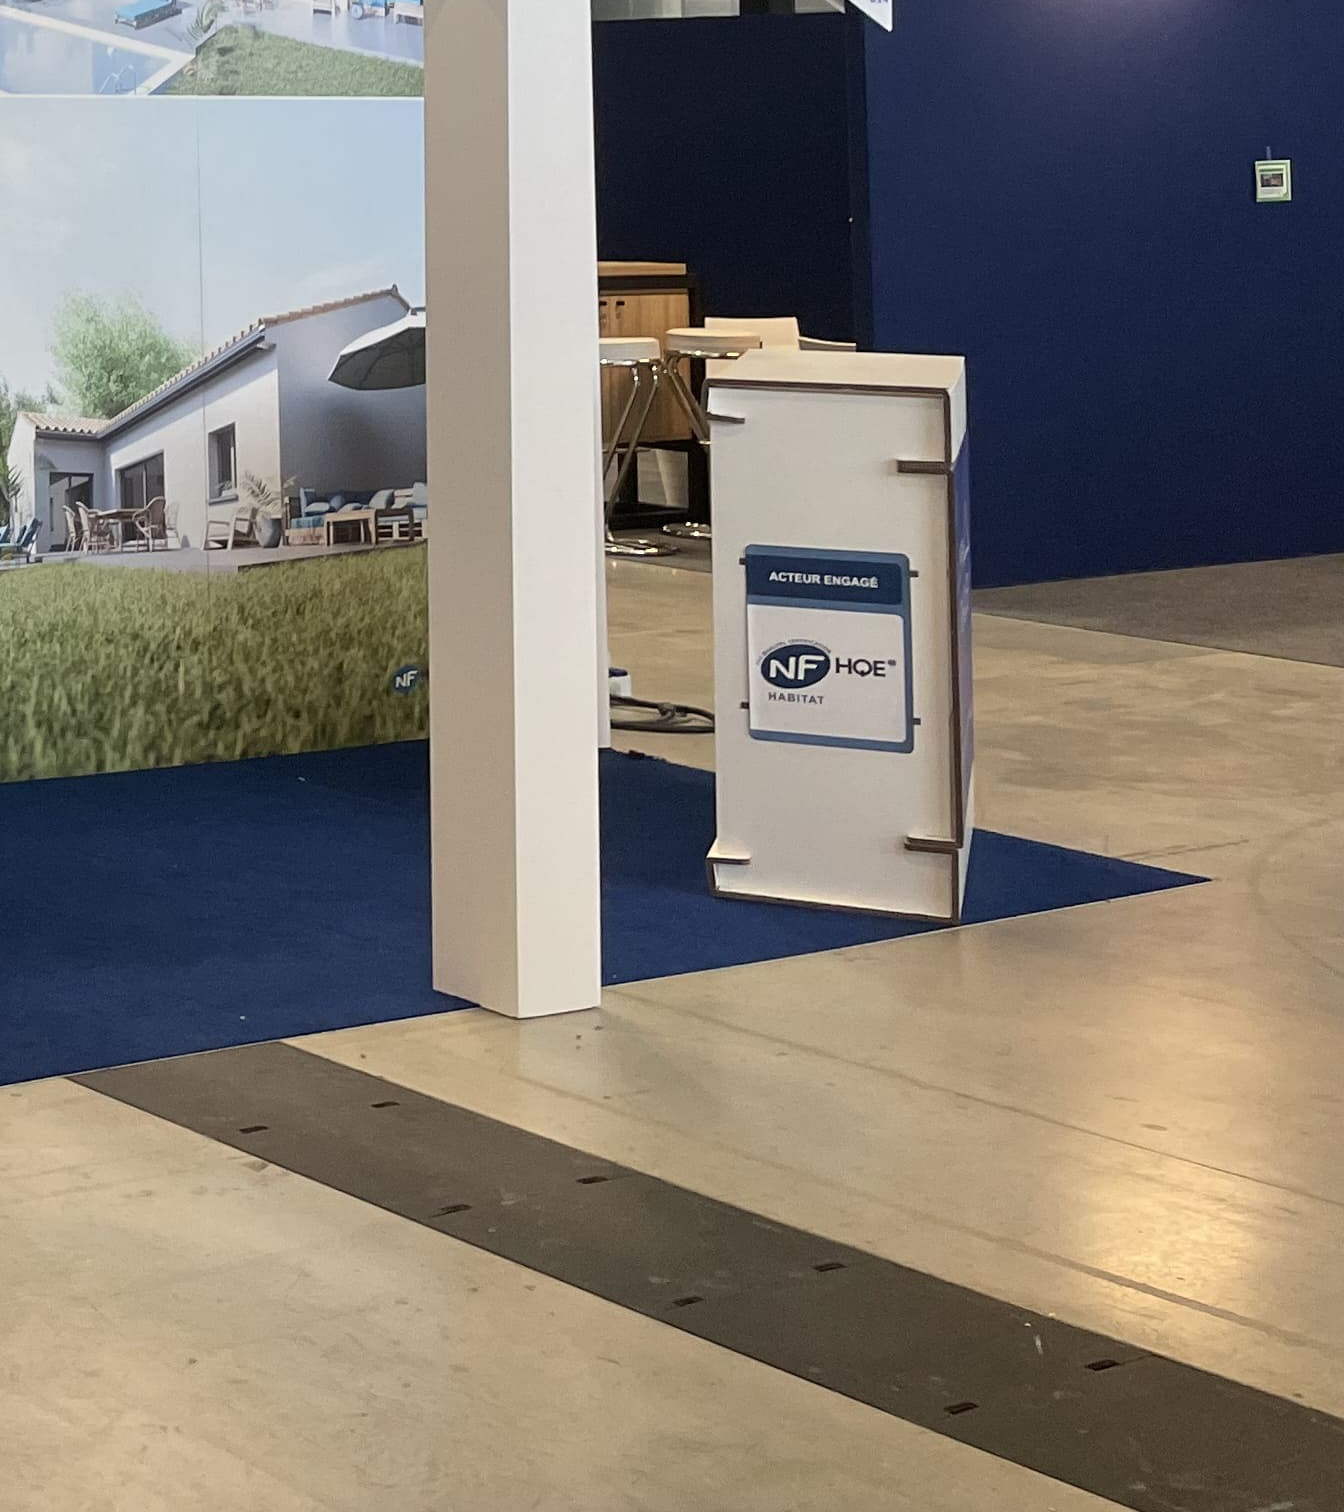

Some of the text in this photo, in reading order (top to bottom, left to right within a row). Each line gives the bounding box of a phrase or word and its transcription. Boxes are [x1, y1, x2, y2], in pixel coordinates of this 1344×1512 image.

[769, 571, 878, 588] ACTEUR ENGAGÉ
[769, 654, 826, 681] NF
[395, 670, 418, 688] NF
[768, 691, 825, 705] HABITAT
